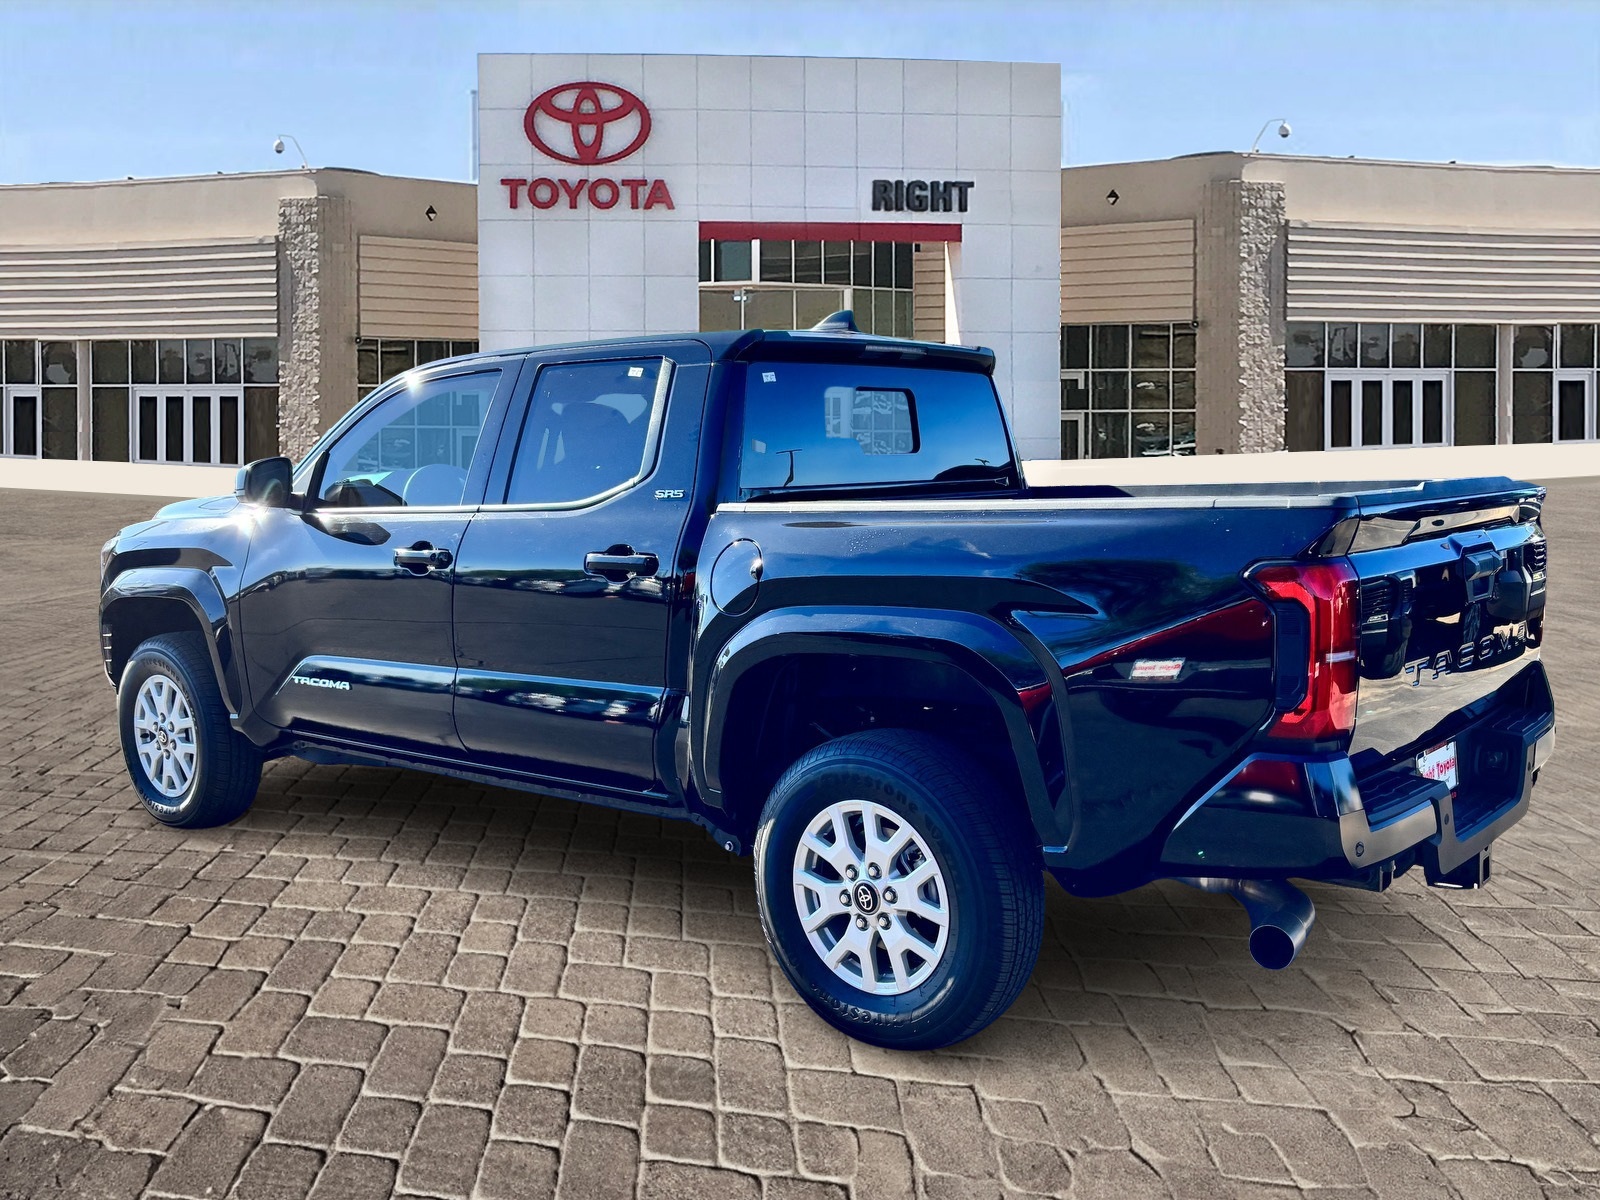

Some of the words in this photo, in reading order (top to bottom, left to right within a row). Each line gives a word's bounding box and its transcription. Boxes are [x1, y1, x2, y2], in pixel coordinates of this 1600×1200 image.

[500, 178, 675, 210] TOYOTA
[871, 179, 975, 212] RIGHT
[654, 489, 685, 499] SR5
[1404, 620, 1528, 686] TACOMA
[292, 676, 351, 691] TACOMA
